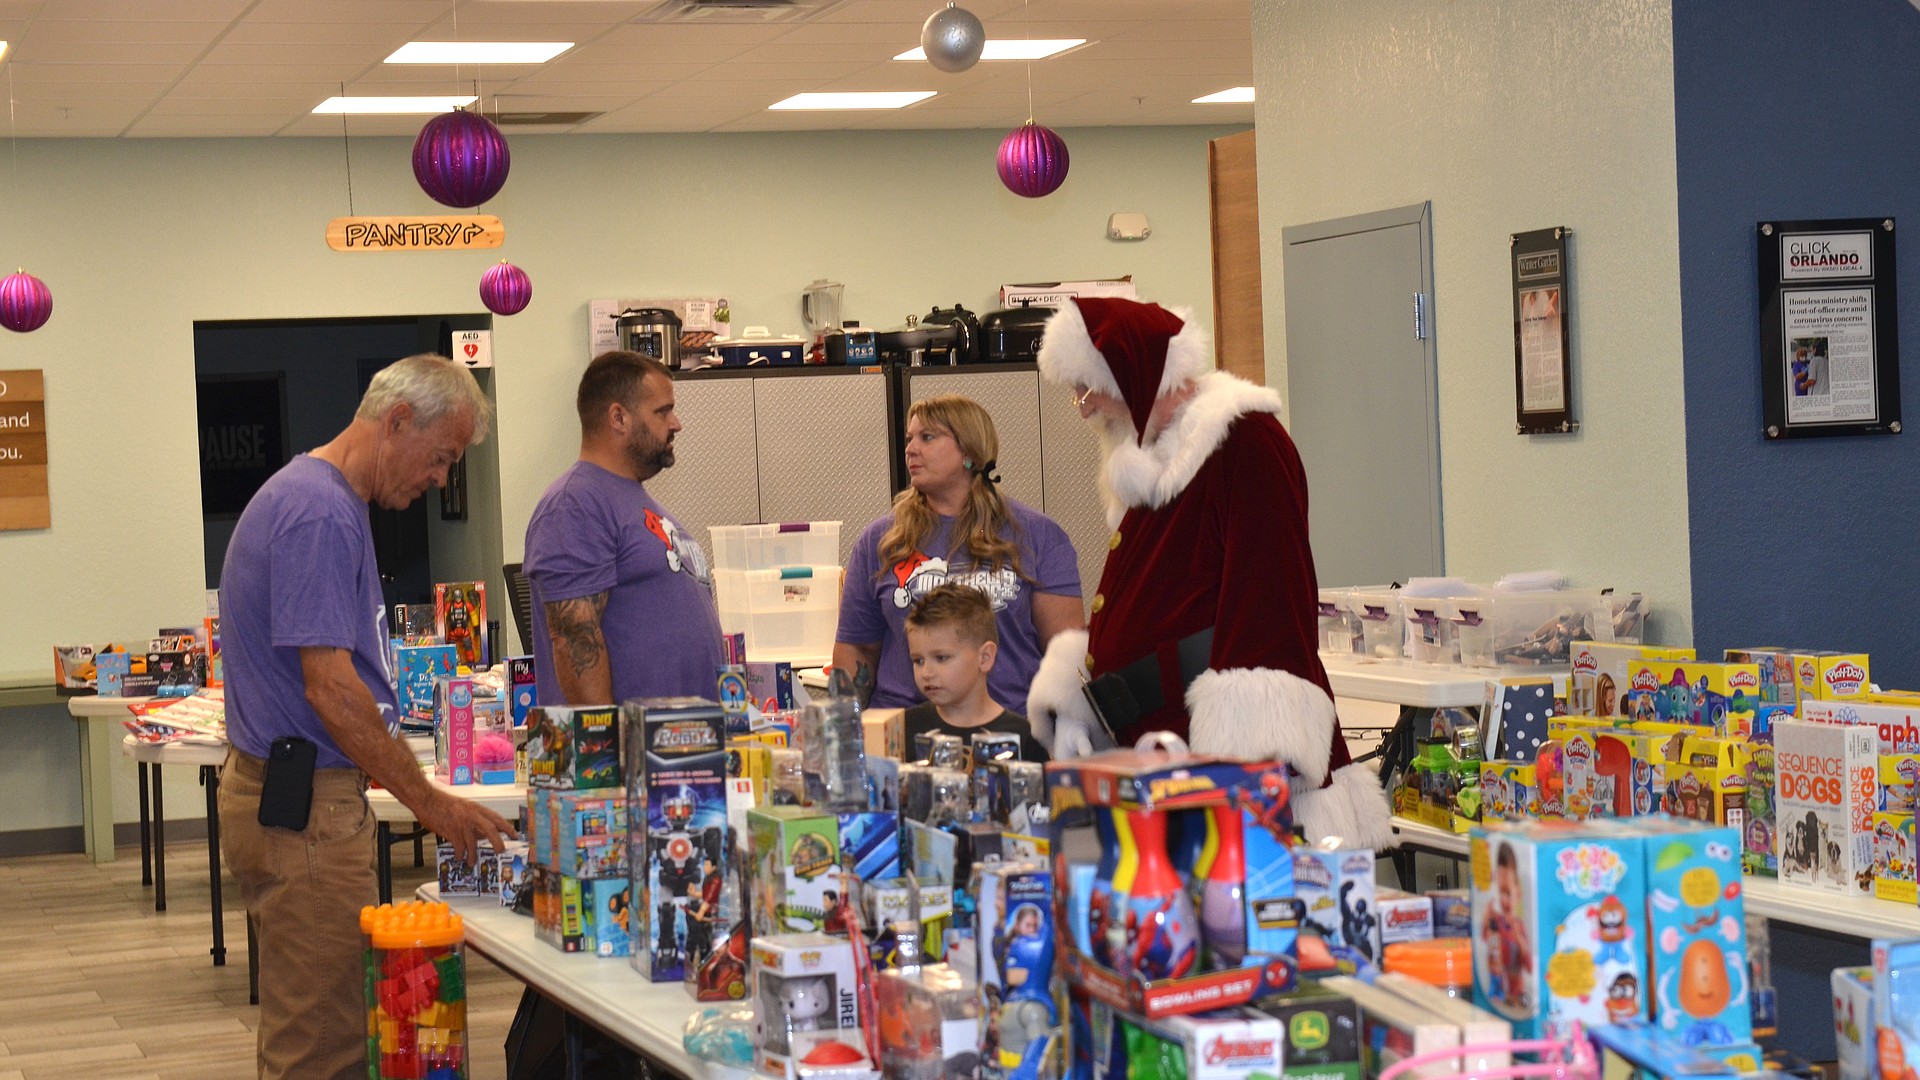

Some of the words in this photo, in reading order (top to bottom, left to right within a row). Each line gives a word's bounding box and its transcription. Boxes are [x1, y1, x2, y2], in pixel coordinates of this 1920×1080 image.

[346, 223, 461, 247] PANTRY
[1790, 241, 1831, 254] CLICK
[1790, 253, 1859, 266] ORLANDO
[1789, 297, 1820, 306] Homeless
[1821, 296, 1848, 305] ministry
[1849, 295, 1867, 303] shifts
[1789, 307, 1796, 315] to
[1796, 306, 1835, 315] out-of-office
[1793, 315, 1832, 324] coronavirus
[462, 332, 479, 340] AED
[200, 424, 266, 461] AUSE
[0, 447, 23, 460] ou.
[514, 662, 529, 674] my
[1825, 667, 1865, 682] Play-Doh
[1729, 673, 1757, 686] Play-Doh
[1832, 682, 1859, 690] KITCHEN
[582, 713, 612, 728] DINO
[531, 760, 555, 776] DINO
[1778, 752, 1843, 777] SEQUENCE
[1780, 772, 1842, 805] DOGS
[1850, 764, 1862, 834] SEQUENCE
[1860, 766, 1876, 832] DOGS
[839, 988, 855, 1030] JIRE
